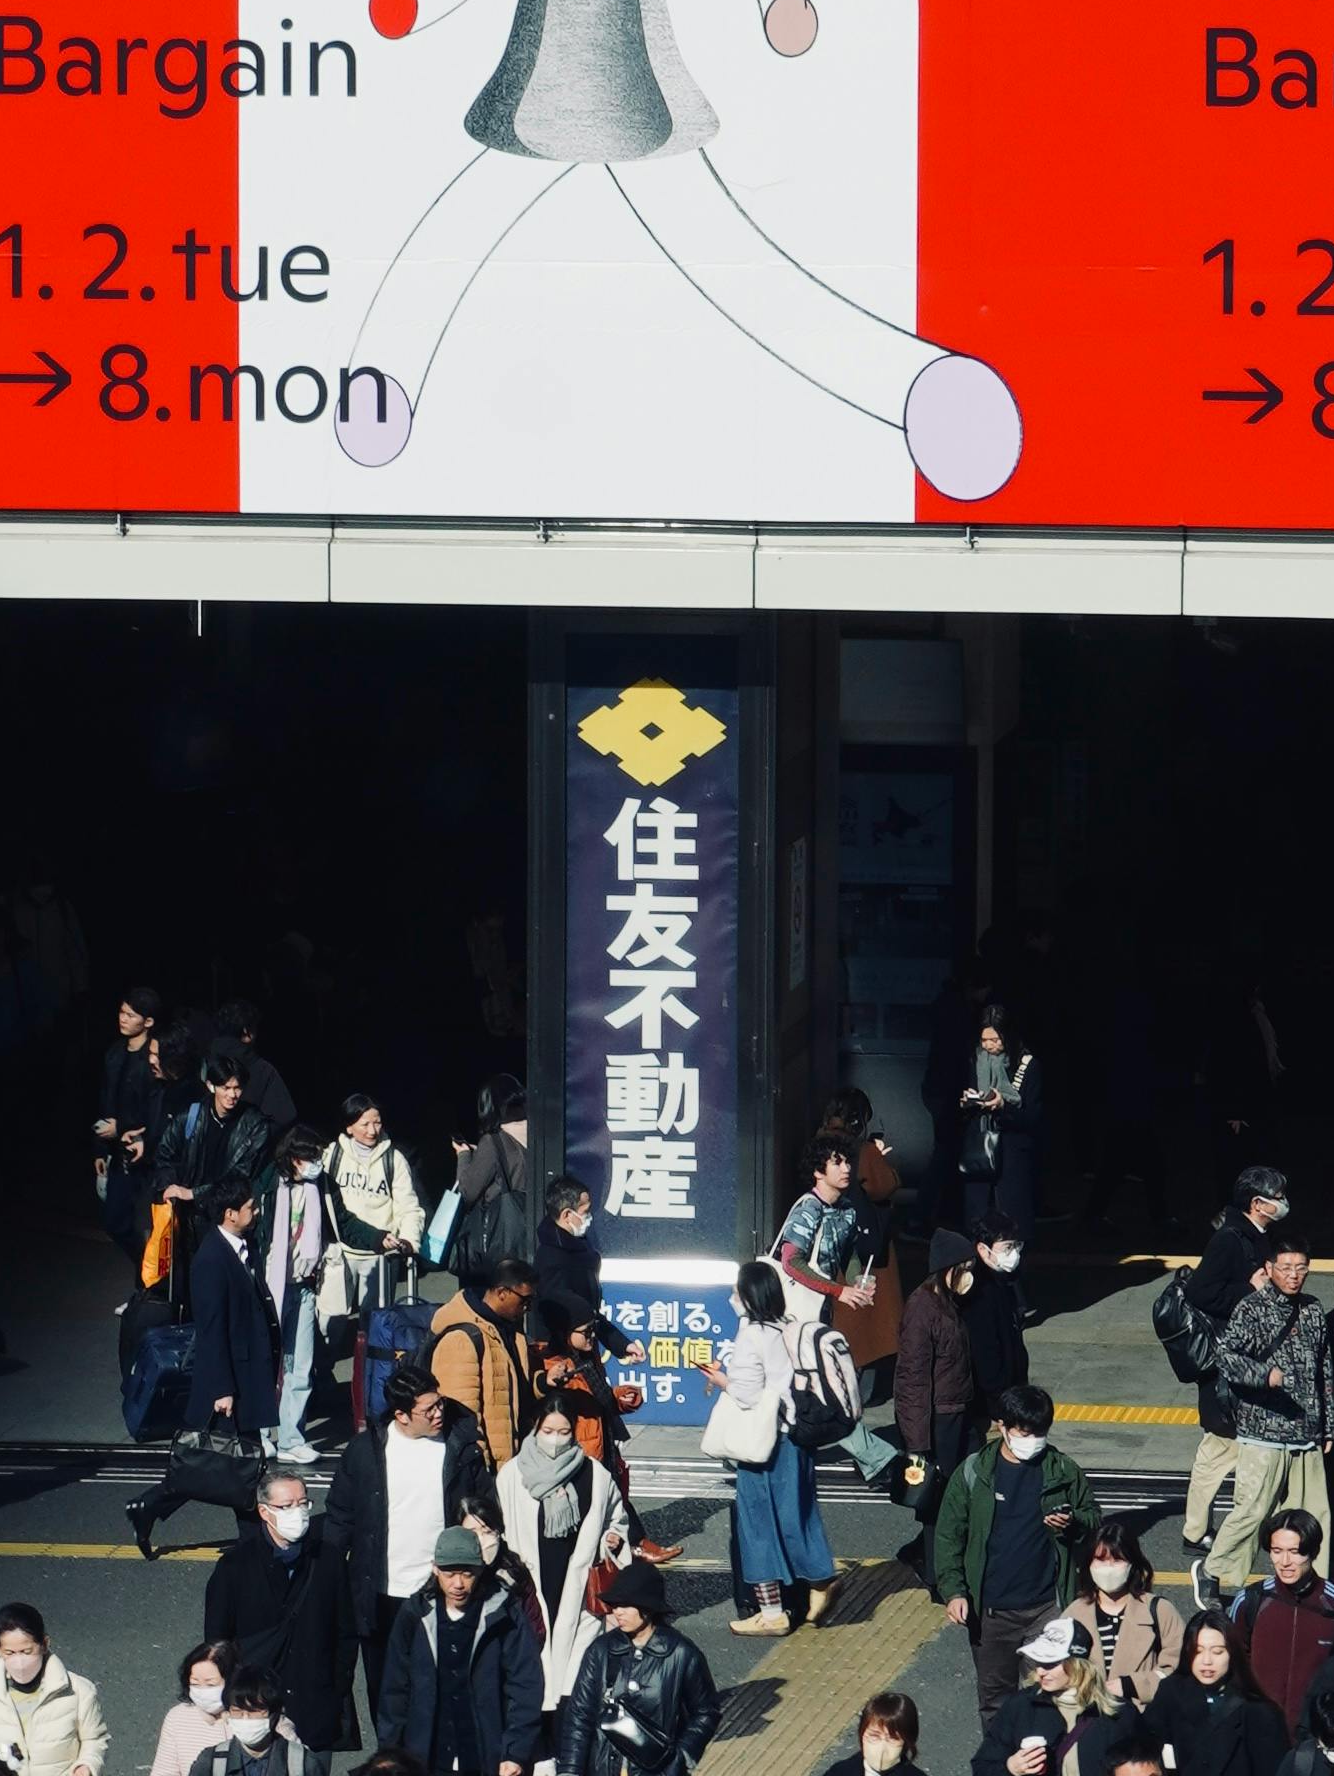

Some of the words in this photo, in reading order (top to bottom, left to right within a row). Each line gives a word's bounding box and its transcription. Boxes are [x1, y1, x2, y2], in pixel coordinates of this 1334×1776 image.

[604, 797, 700, 1220] 住友不動産
